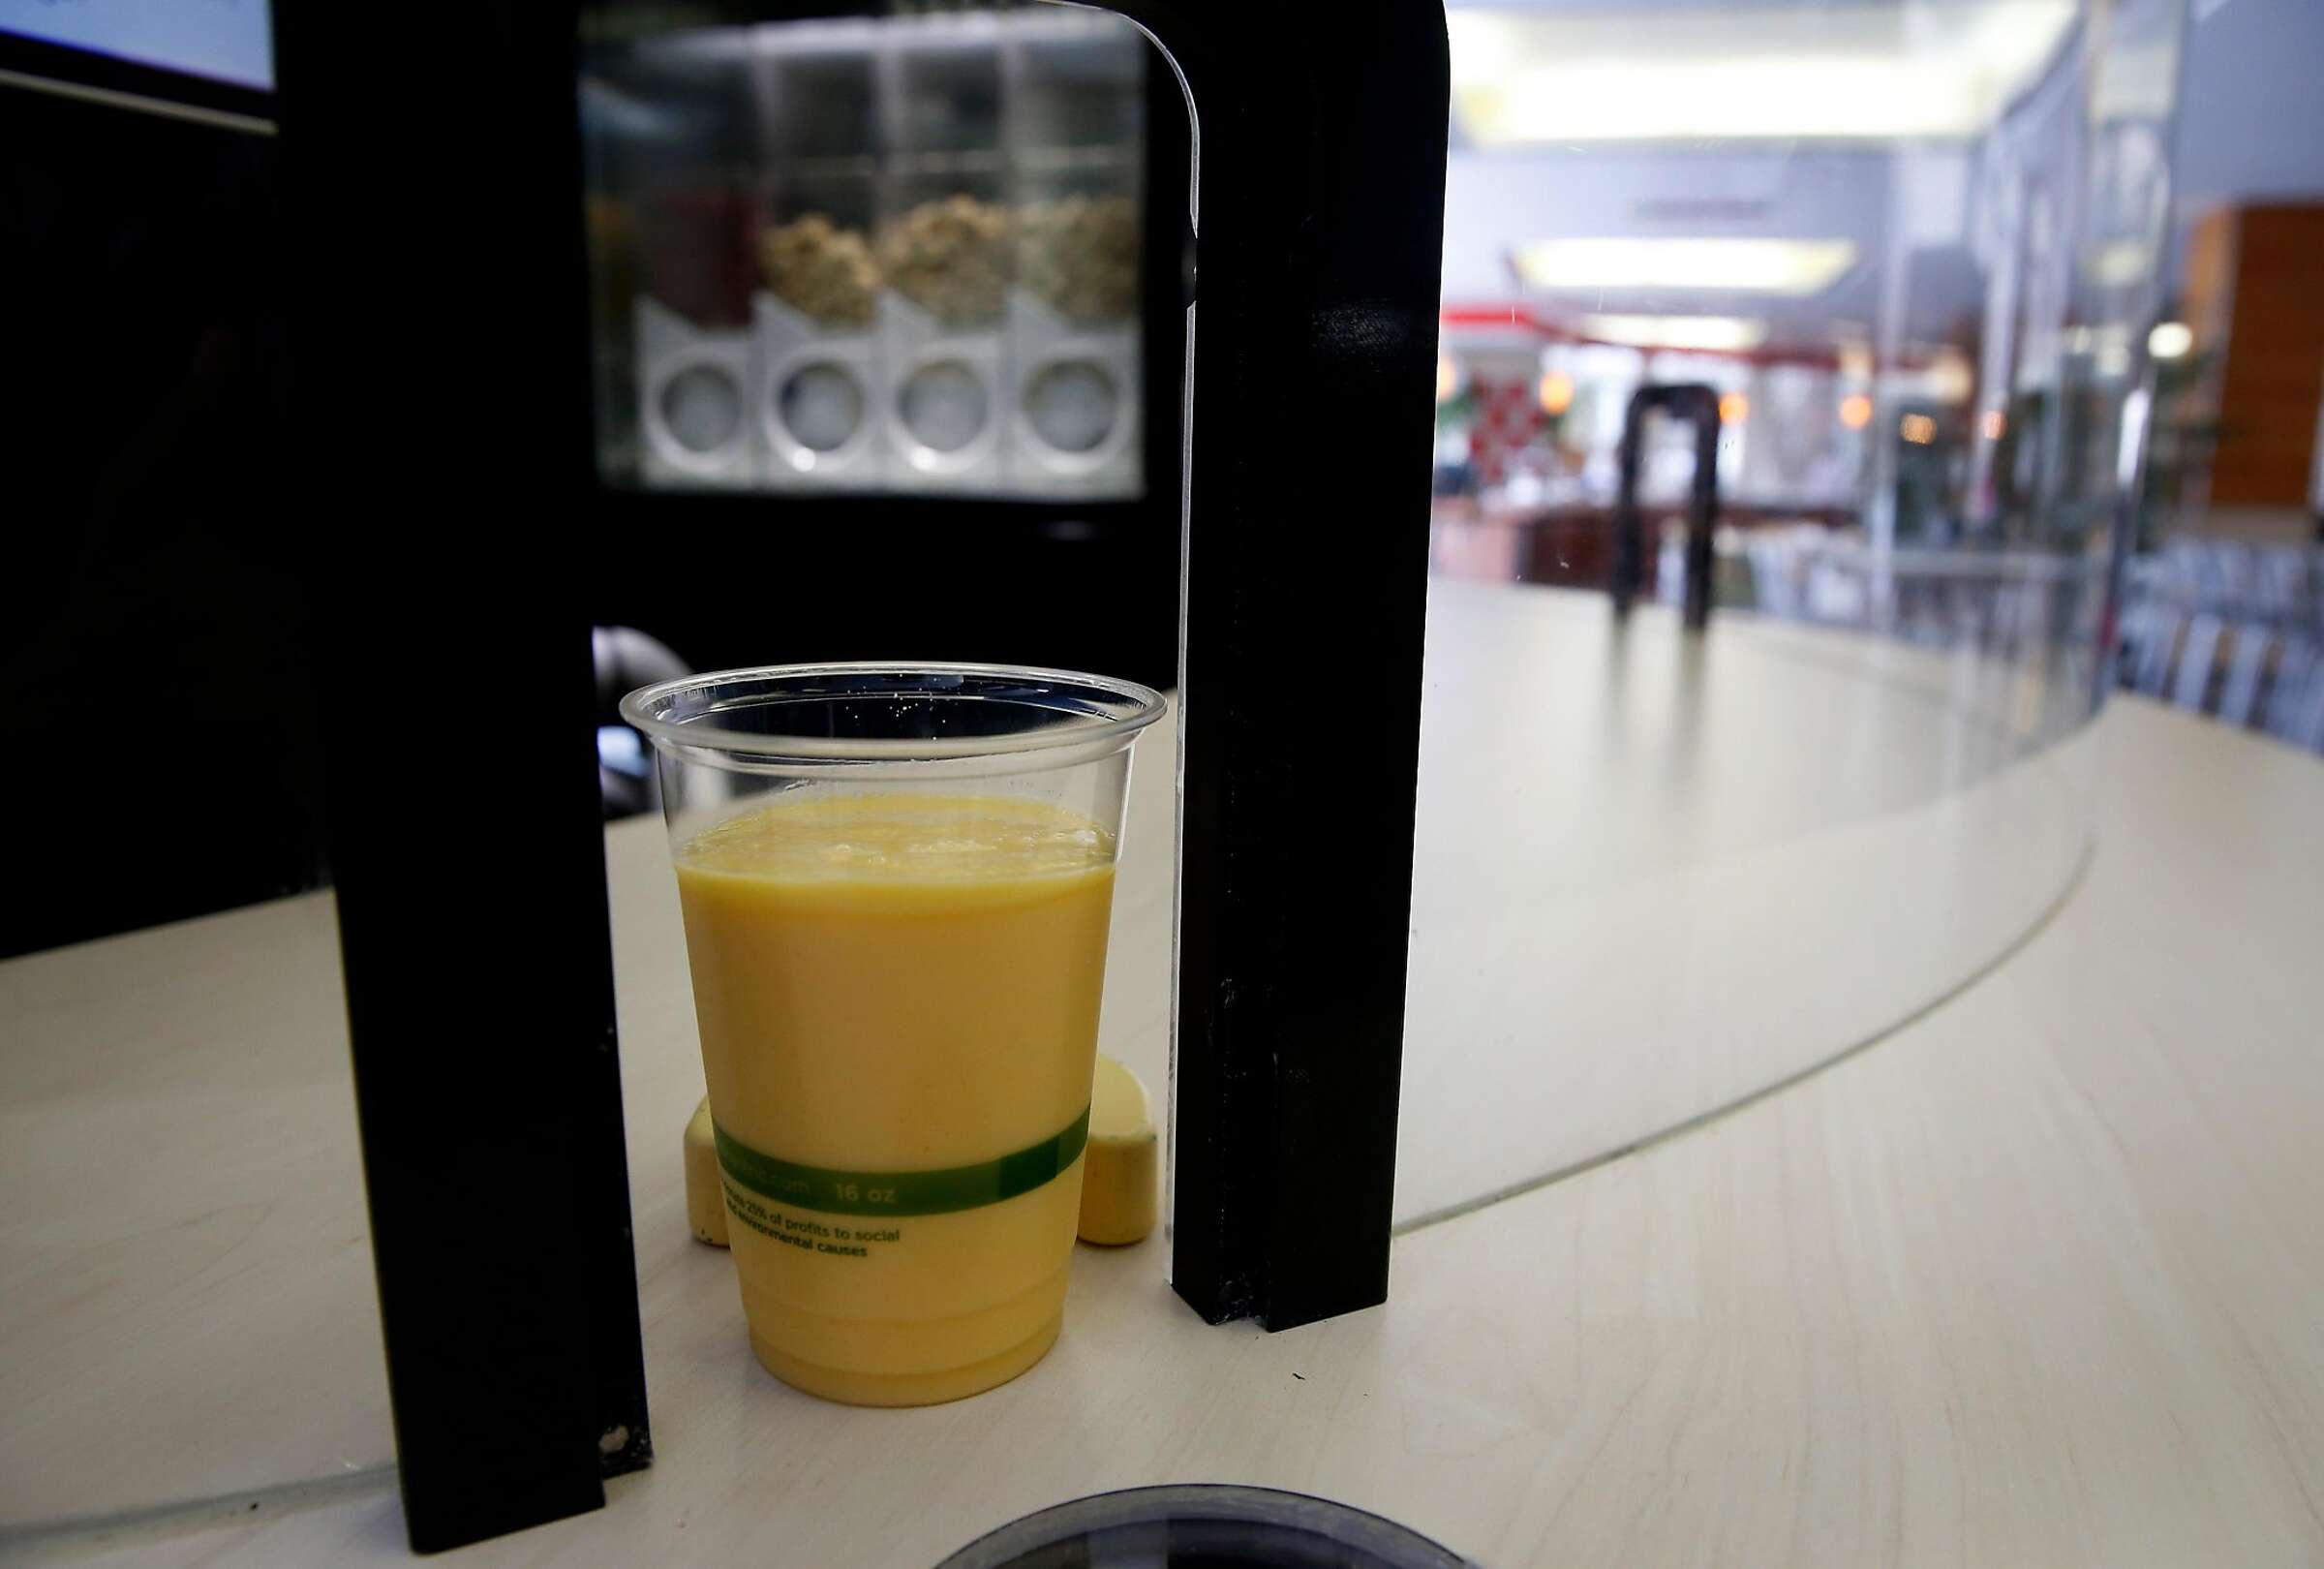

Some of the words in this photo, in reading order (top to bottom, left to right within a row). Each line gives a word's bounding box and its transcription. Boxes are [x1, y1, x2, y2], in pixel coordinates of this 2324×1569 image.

[837, 1183, 860, 1202] 16
[867, 1187, 897, 1204] oz
[770, 1213, 781, 1226] of
[785, 1218, 830, 1238] profits
[835, 1227, 850, 1241] to
[855, 1229, 900, 1243] social
[817, 1241, 868, 1258] causes
